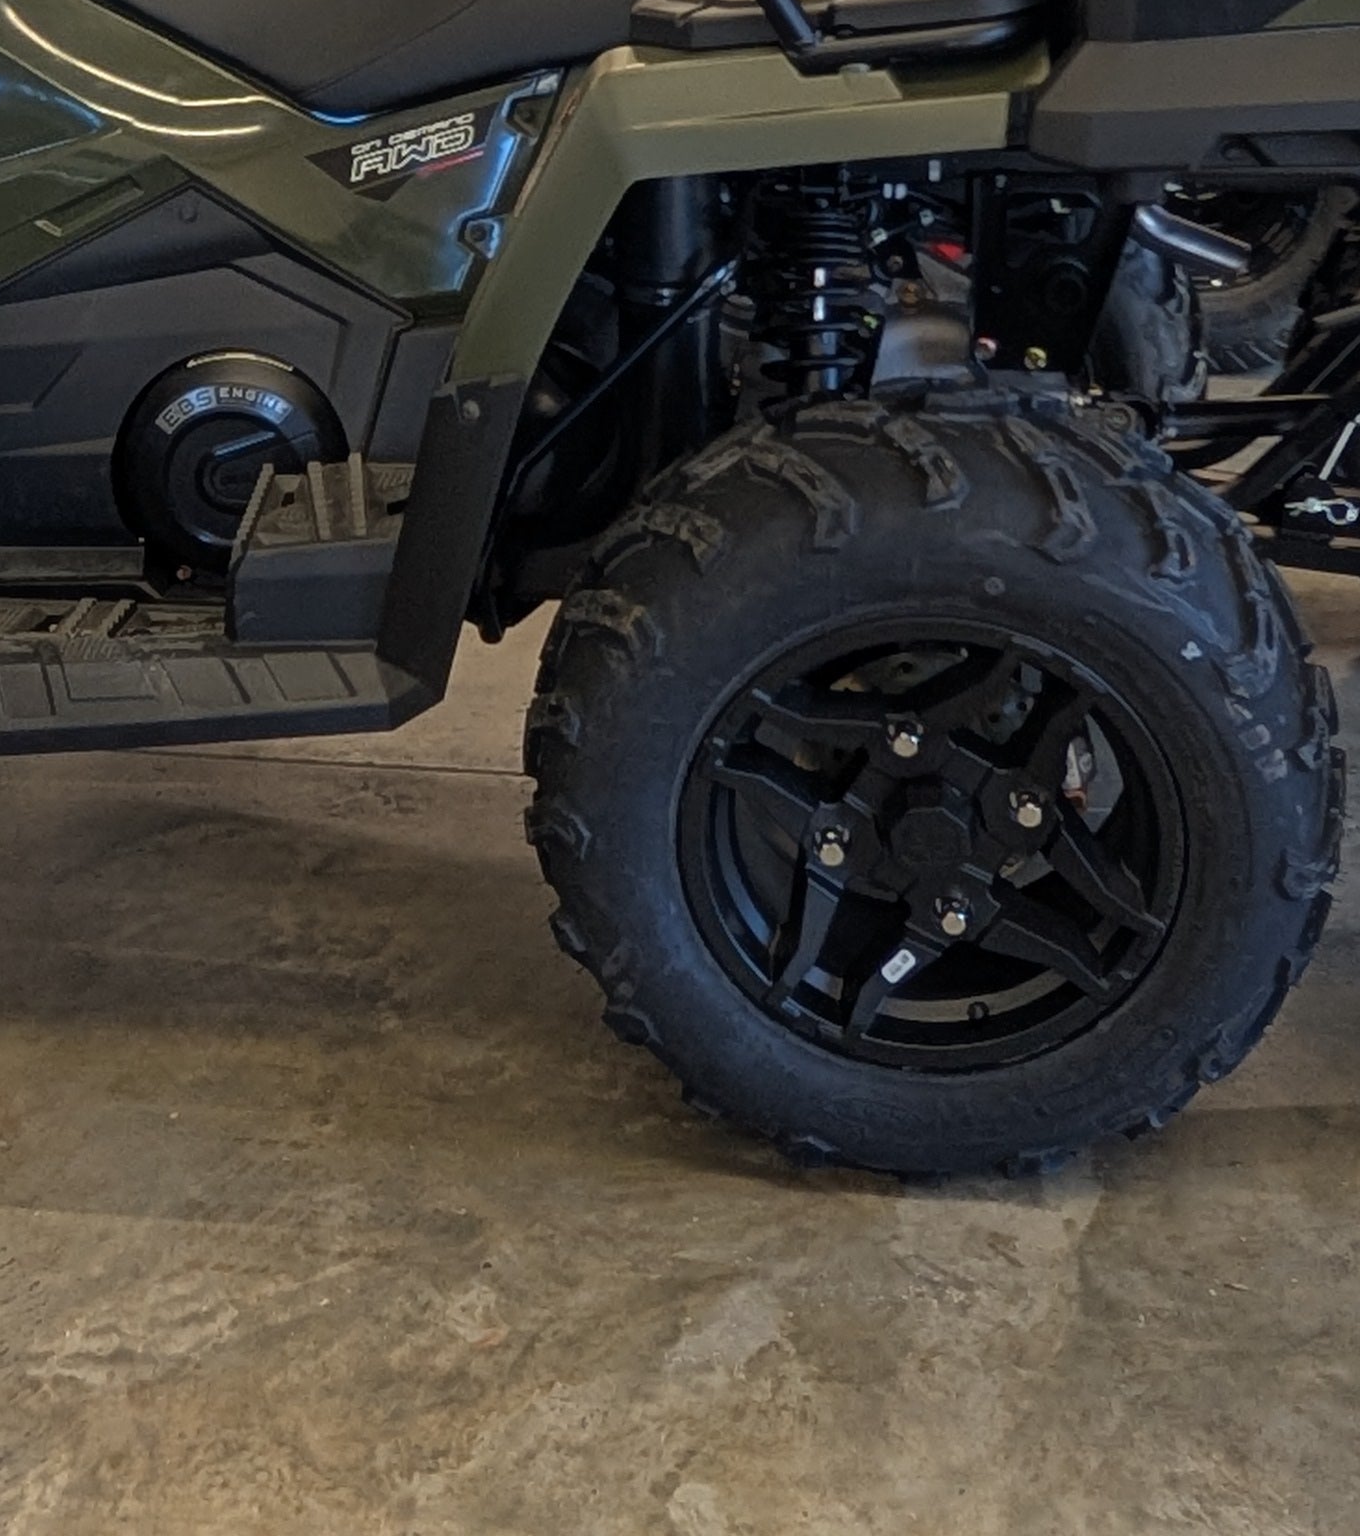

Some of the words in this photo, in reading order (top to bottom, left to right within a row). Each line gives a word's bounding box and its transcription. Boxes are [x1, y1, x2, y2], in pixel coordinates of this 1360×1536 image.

[349, 124, 476, 183] AWD
[161, 387, 214, 428] EBS
[218, 386, 288, 414] ENGINE
